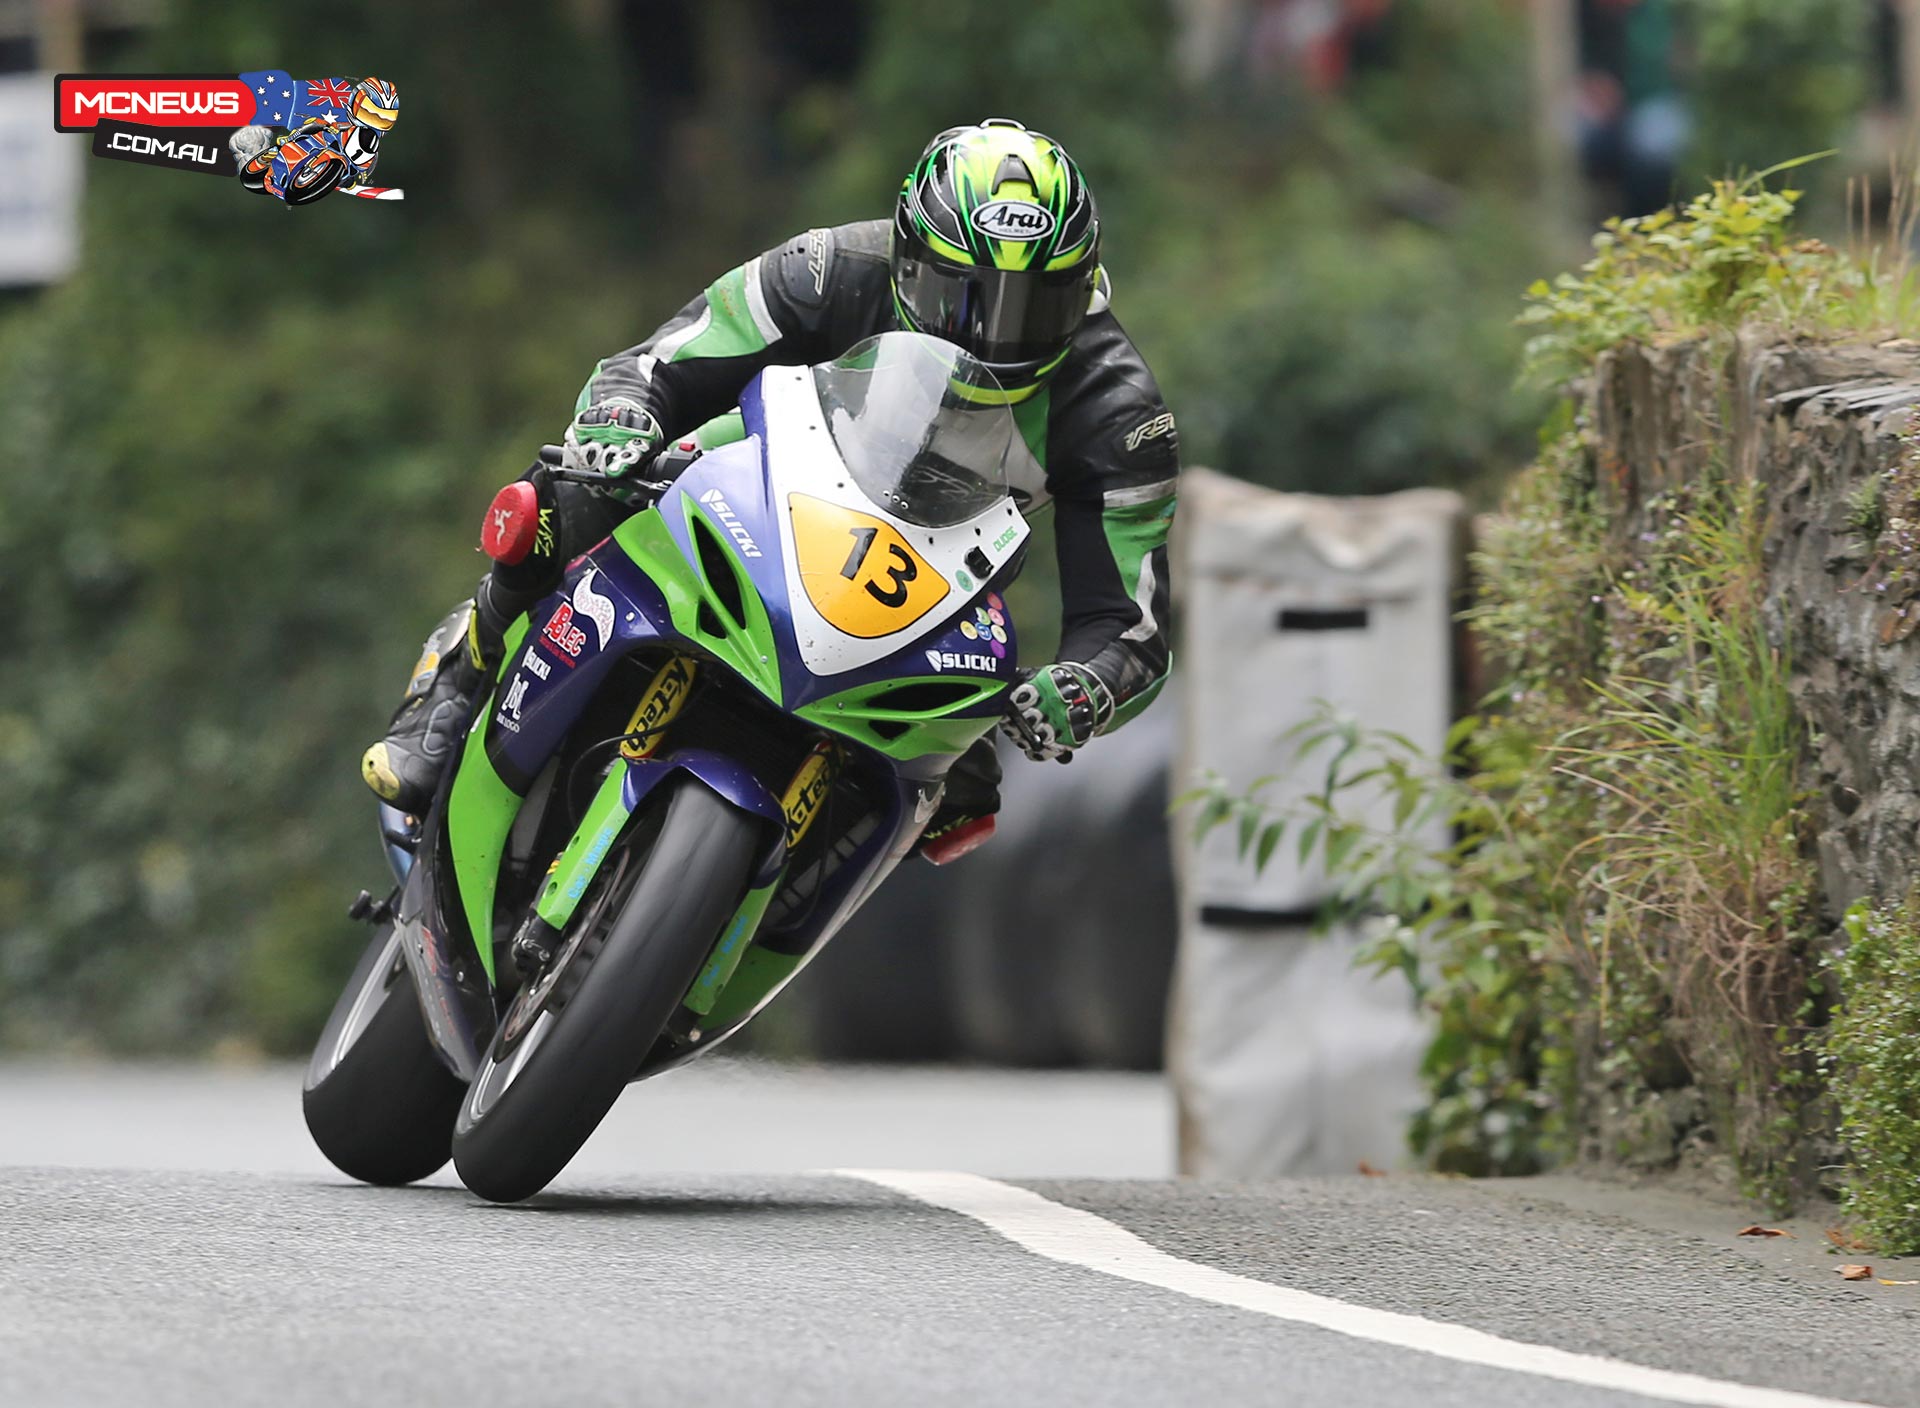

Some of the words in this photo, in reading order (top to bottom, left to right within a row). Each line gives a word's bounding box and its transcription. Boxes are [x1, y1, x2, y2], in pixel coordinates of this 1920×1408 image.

[979, 205, 1044, 229] Arai
[708, 501, 763, 558] SLICK!
[840, 527, 917, 608] 13
[941, 652, 997, 673] SLICK!
